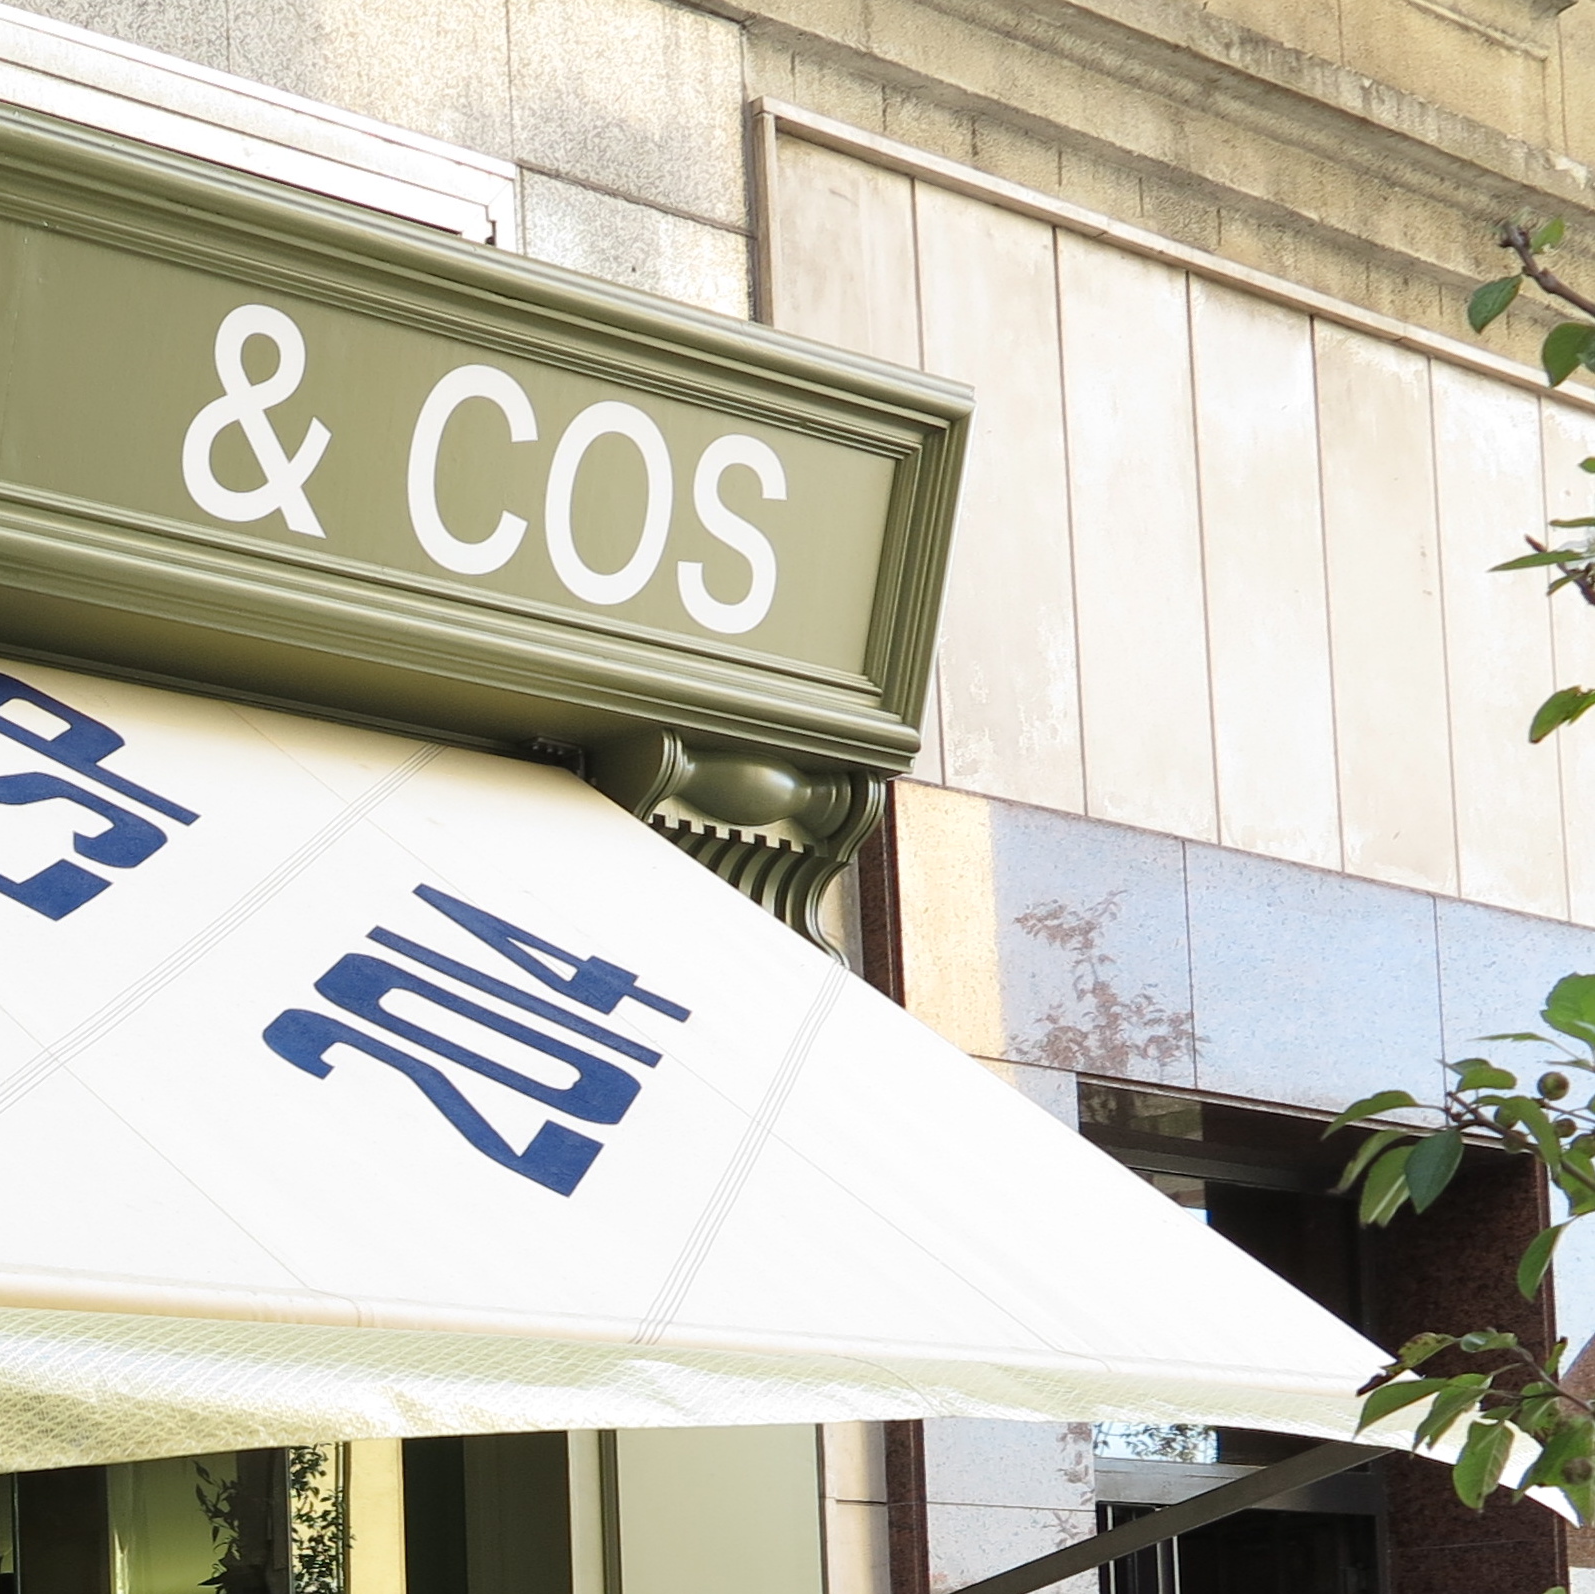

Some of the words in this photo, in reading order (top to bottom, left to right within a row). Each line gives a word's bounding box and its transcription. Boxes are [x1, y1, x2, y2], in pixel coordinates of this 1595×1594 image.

[182, 304, 332, 539] &
[408, 363, 788, 634] COS
[263, 883, 692, 1198] 2014
